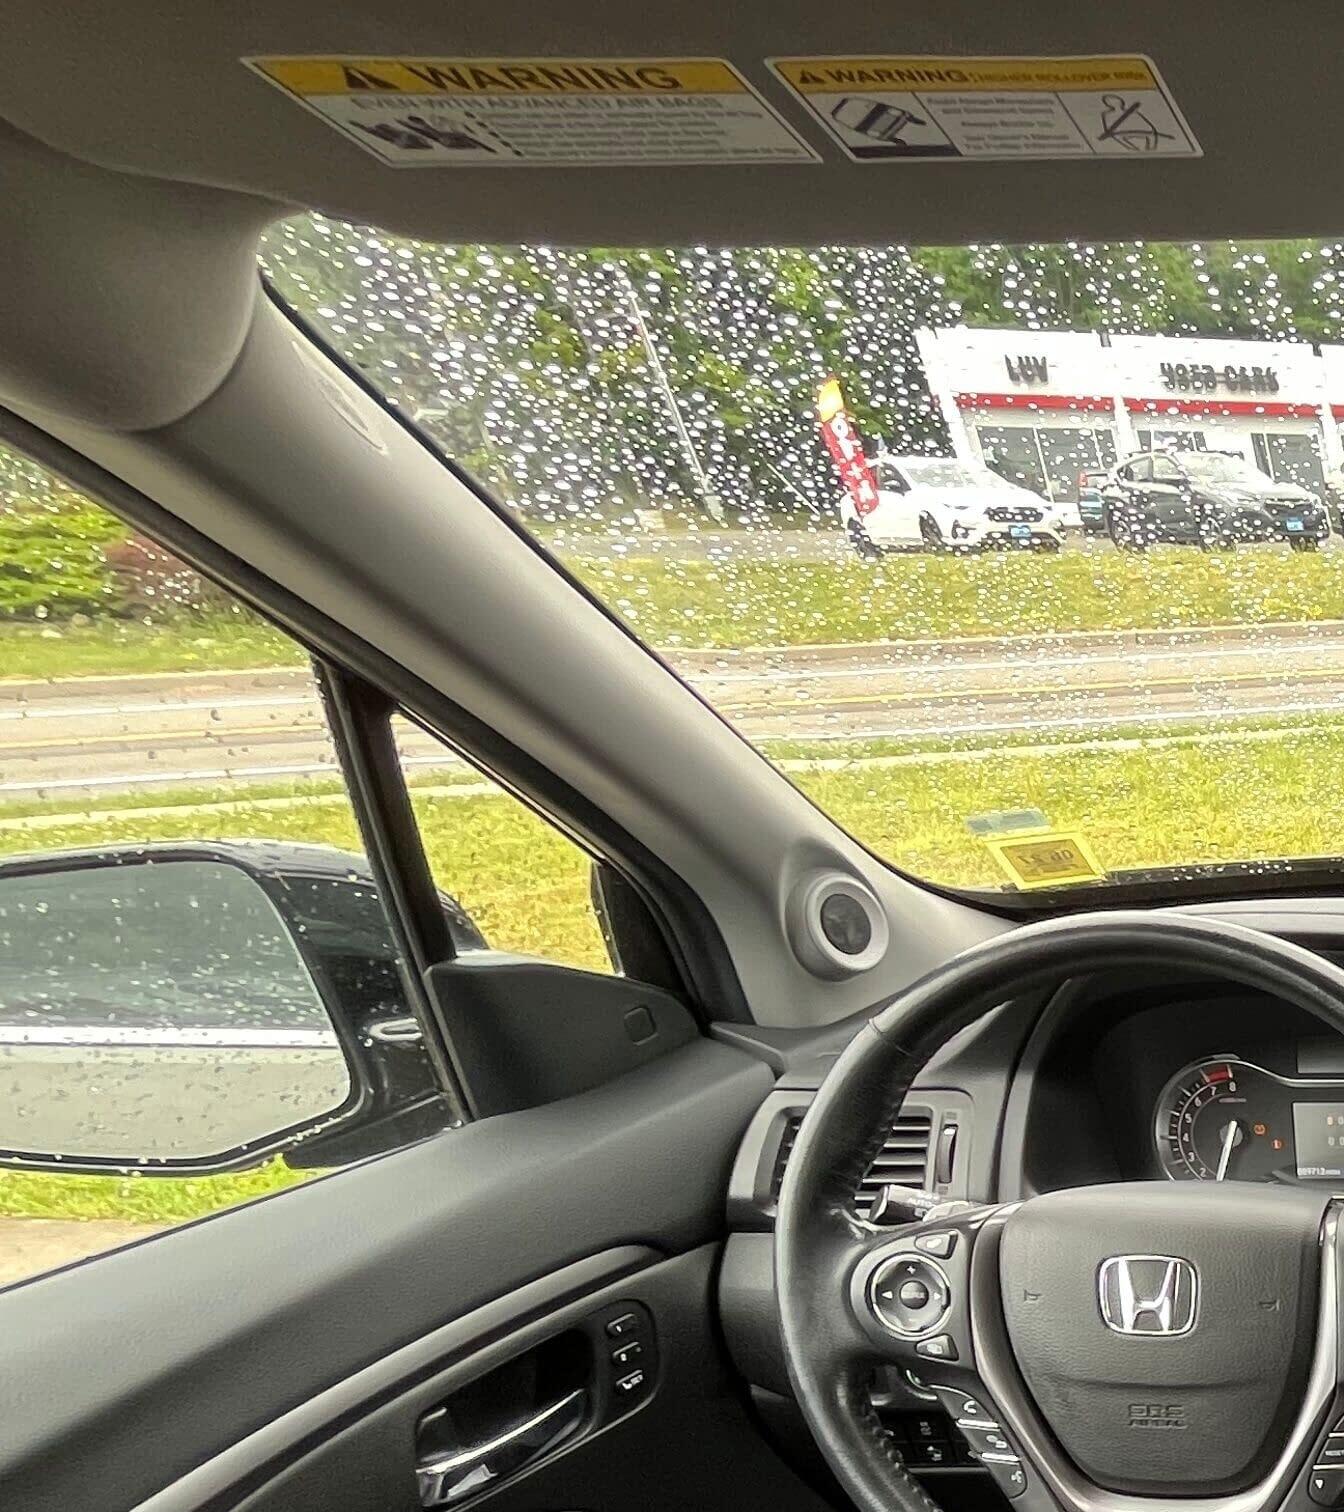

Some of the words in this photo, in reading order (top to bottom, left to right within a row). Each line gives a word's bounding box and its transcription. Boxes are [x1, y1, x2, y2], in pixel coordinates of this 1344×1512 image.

[405, 66, 683, 90] WARNING
[1194, 1096, 1202, 1107] 6
[1184, 1113, 1192, 1124] 5
[1182, 1132, 1190, 1142] 4
[1187, 1151, 1195, 1162] 3
